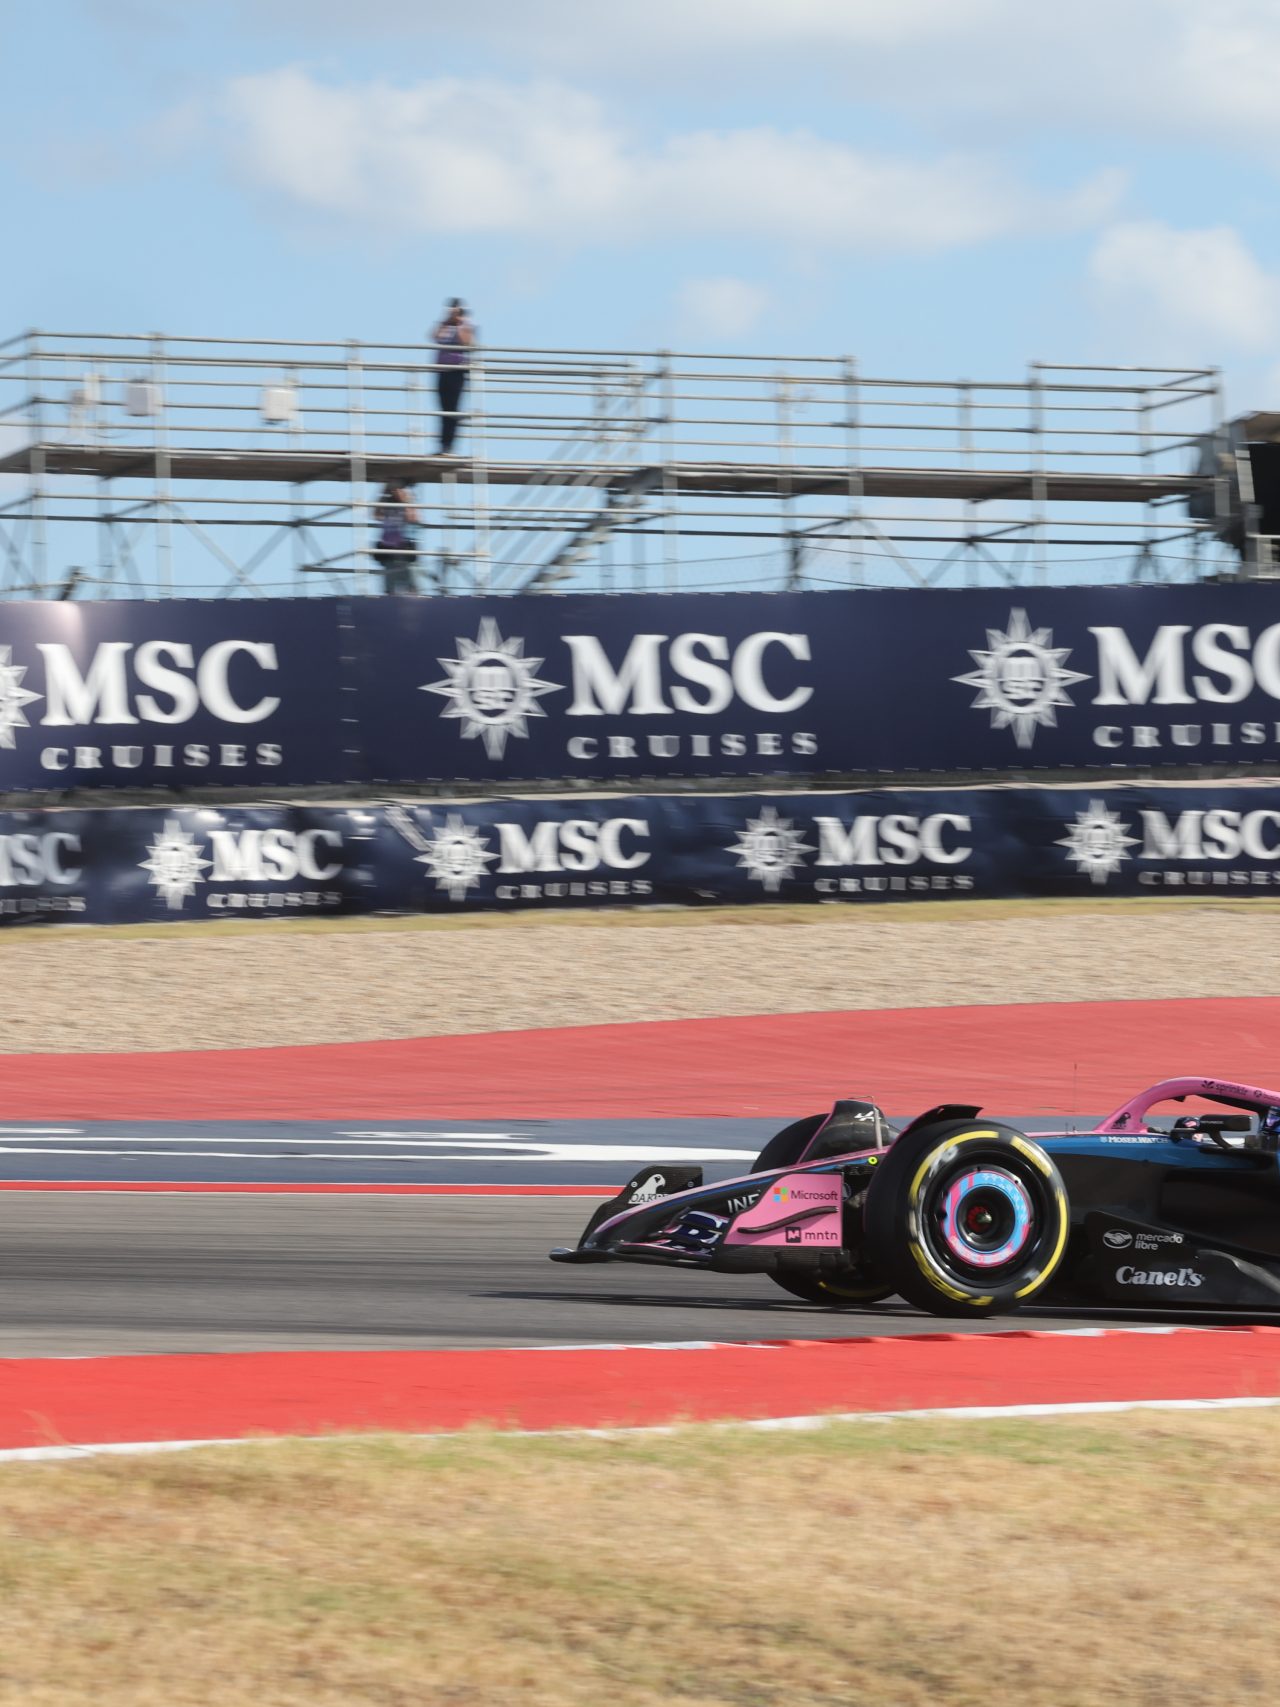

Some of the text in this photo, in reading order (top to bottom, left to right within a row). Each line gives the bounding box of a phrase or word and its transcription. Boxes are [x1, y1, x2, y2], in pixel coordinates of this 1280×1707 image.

[36, 640, 279, 726] MSC
[562, 632, 813, 716] MSC
[40, 743, 282, 770] CRUISES
[567, 732, 818, 760] CRUISES
[496, 818, 650, 874] MSC
[813, 814, 972, 866] MSC
[207, 829, 342, 882] MSC
[814, 875, 973, 893] CRUISES
[790, 1190, 838, 1201] Microsoft
[804, 1231, 838, 1241] mntn
[1134, 1240, 1159, 1250] libre
[1136, 1233, 1184, 1244] mercado
[1115, 1266, 1203, 1287] Canel's
